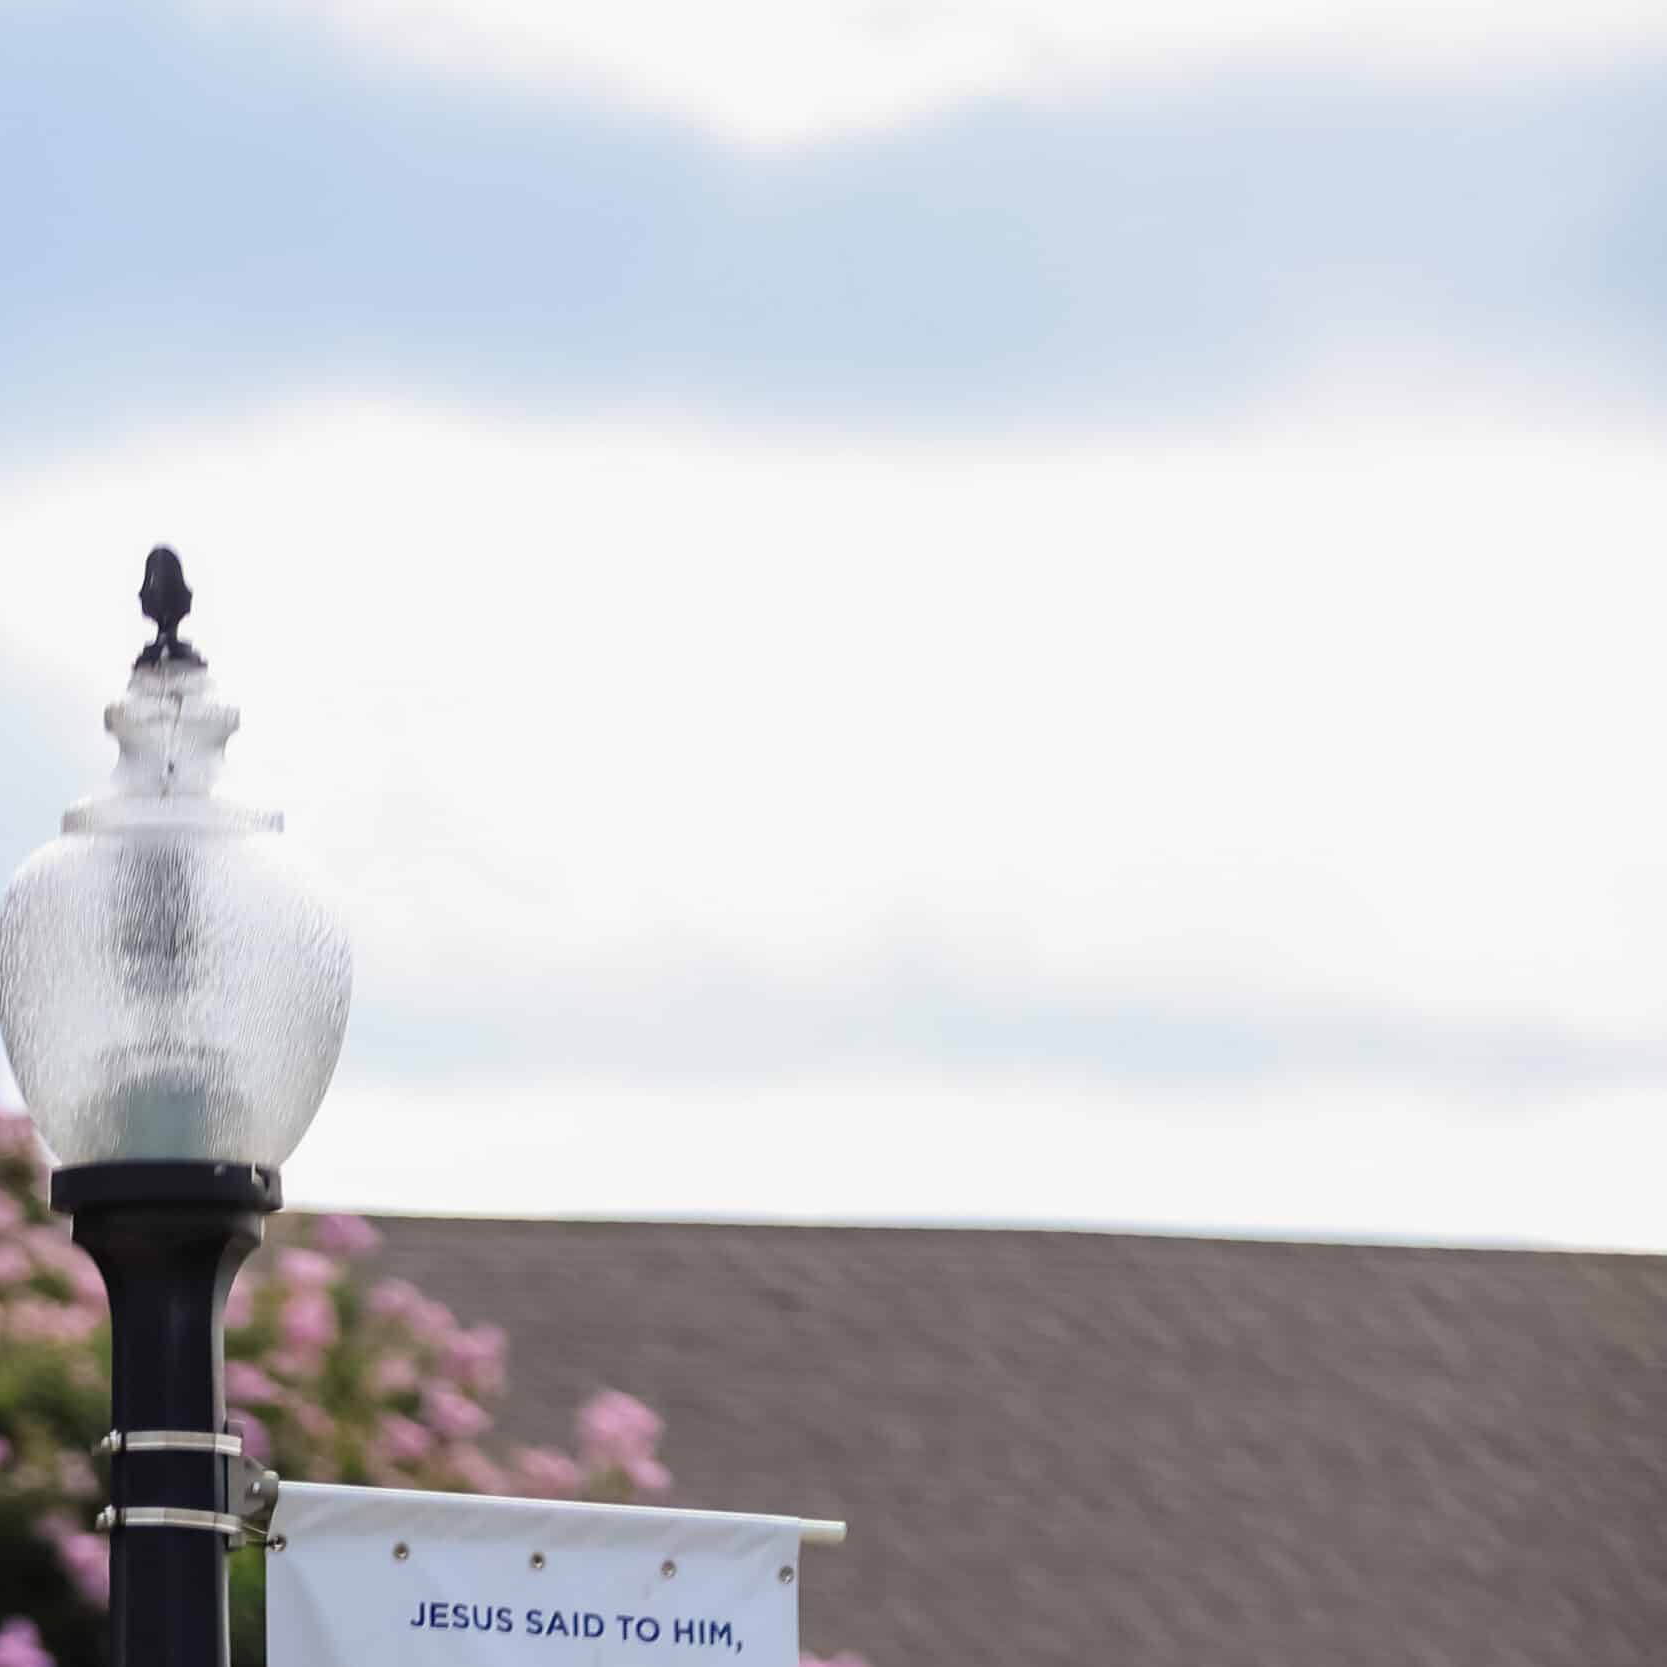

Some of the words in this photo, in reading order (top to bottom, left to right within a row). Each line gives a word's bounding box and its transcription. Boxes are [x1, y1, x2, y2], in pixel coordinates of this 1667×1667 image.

[410, 1602, 513, 1632] JESUS
[526, 1609, 604, 1638] SAID
[617, 1615, 660, 1642] TO
[674, 1619, 742, 1653] HIM,
